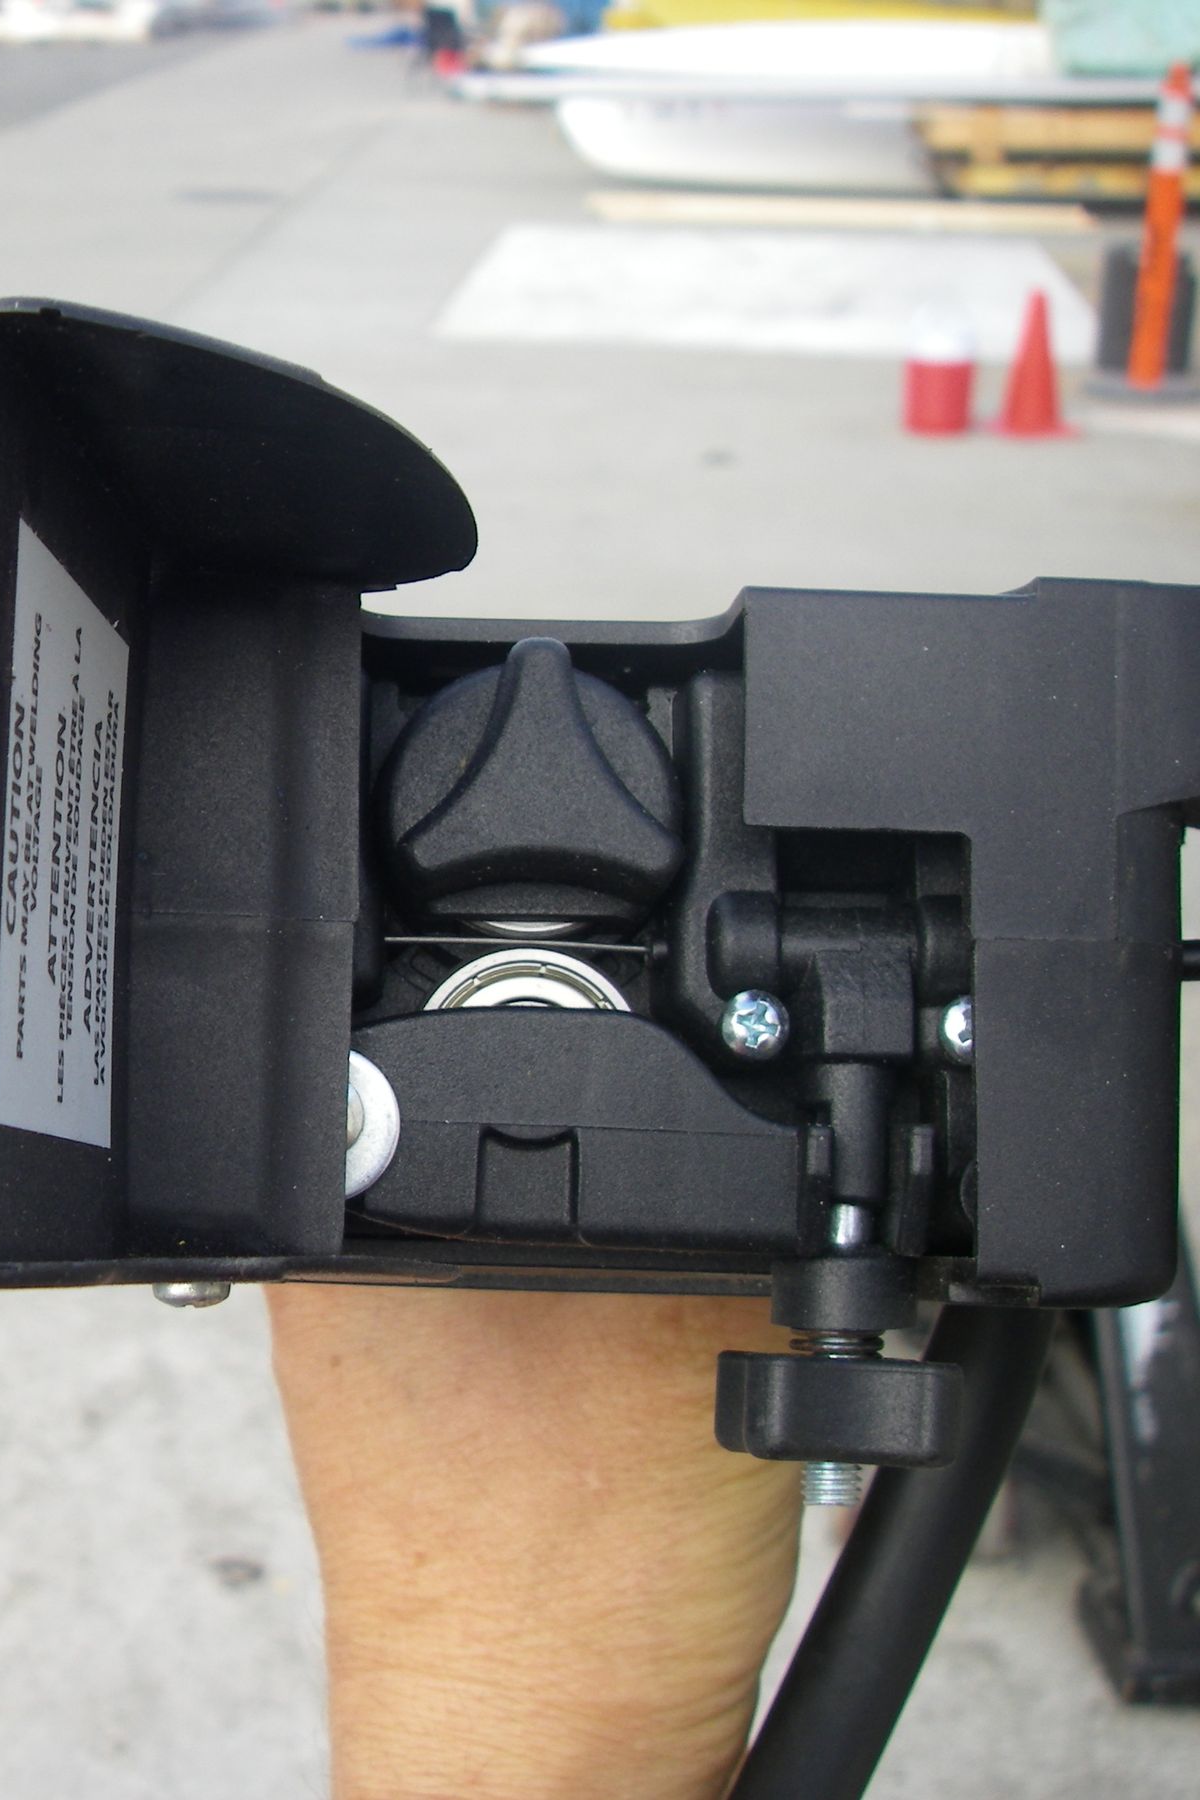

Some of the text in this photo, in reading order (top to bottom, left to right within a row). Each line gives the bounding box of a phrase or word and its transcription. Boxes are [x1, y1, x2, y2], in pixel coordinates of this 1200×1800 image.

[5, 701, 26, 936] CAUTION
[16, 612, 43, 1060] PARTS MAY BE AT WELDING
[29, 764, 43, 913] VOLTAGE
[47, 712, 67, 986] ATTENTION
[56, 1049, 65, 1104] LES
[62, 780, 74, 928] PEUVENT
[74, 626, 82, 665] LA
[65, 694, 86, 1041] TENSION DE SOUDAGE
[83, 720, 103, 1035] ADVERTENCIA
[93, 689, 114, 1086] LAS PARTES PUEDEN ESTAR
[103, 888, 111, 929] DE
[105, 701, 120, 883] SOLDADURA
[99, 1064, 106, 1087] A
